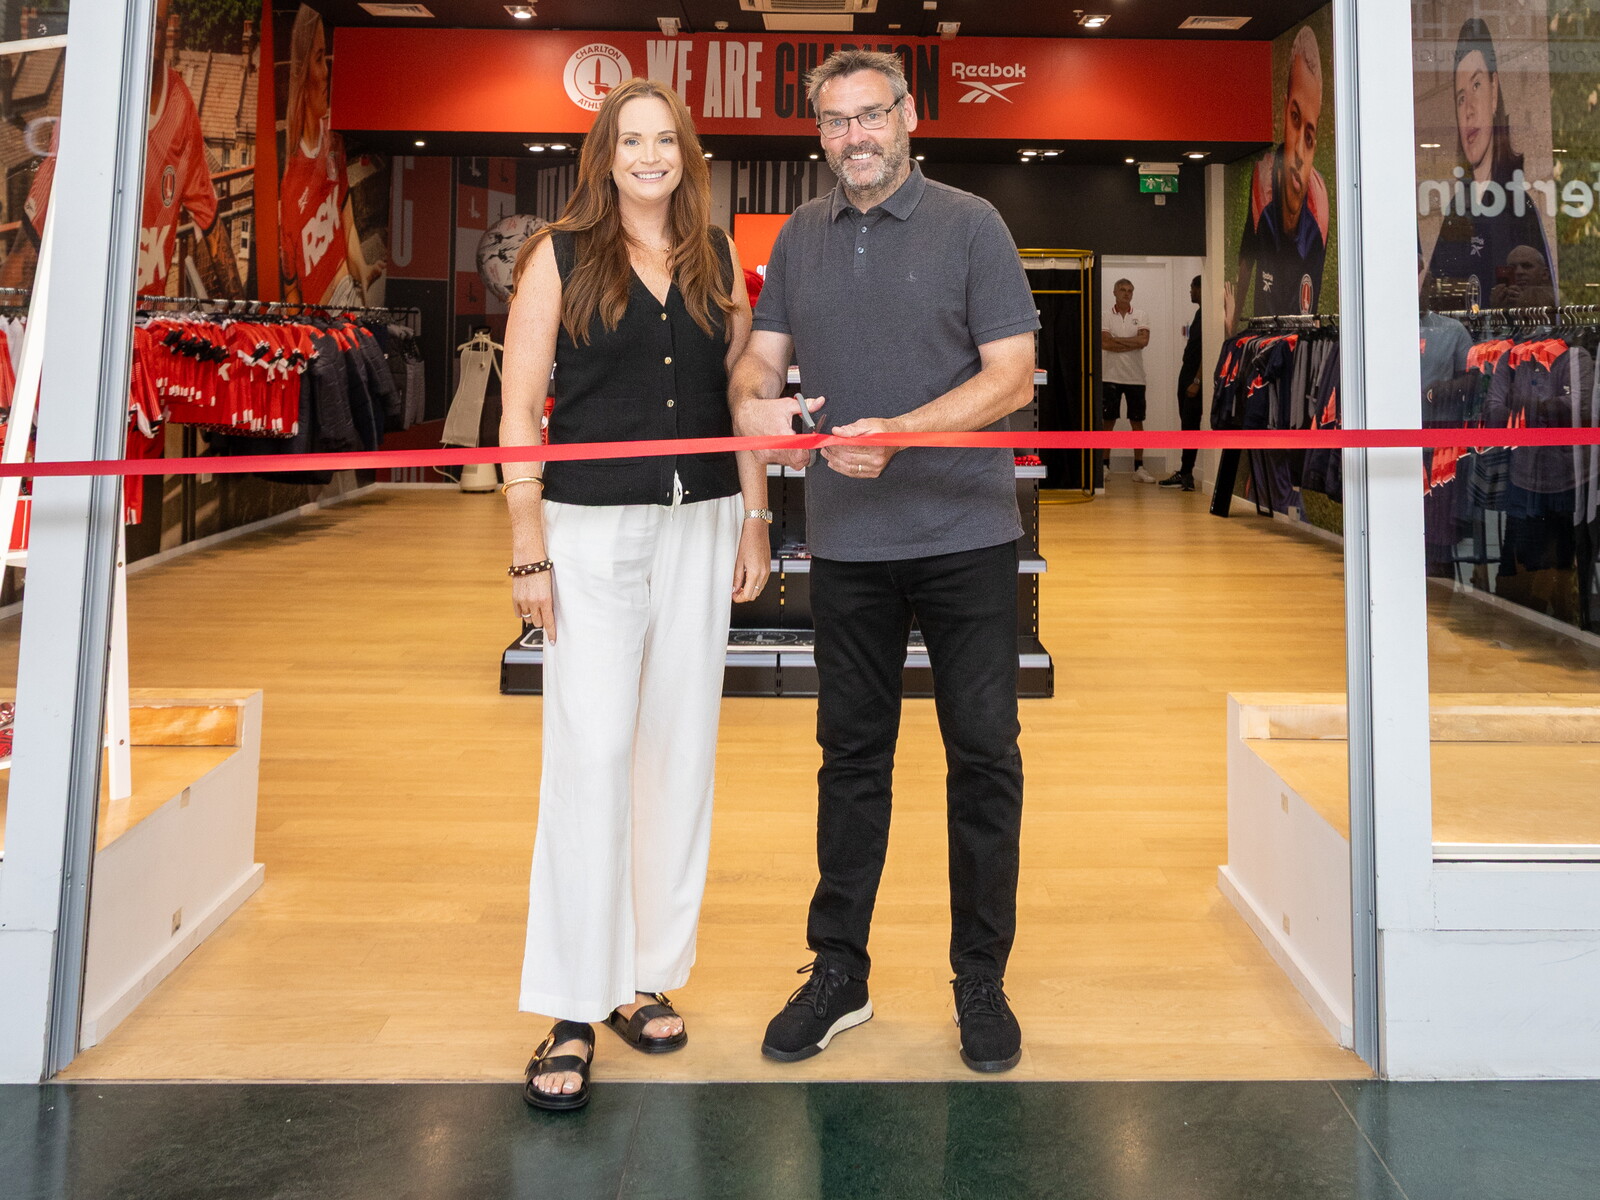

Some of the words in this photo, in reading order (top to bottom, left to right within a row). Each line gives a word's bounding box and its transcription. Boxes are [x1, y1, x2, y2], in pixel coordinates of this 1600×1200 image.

[575, 45, 622, 60] CHARLTON
[951, 61, 1026, 80] Reebok
[646, 39, 693, 114] WE
[702, 40, 763, 119] ARE
[301, 184, 340, 277] RSK
